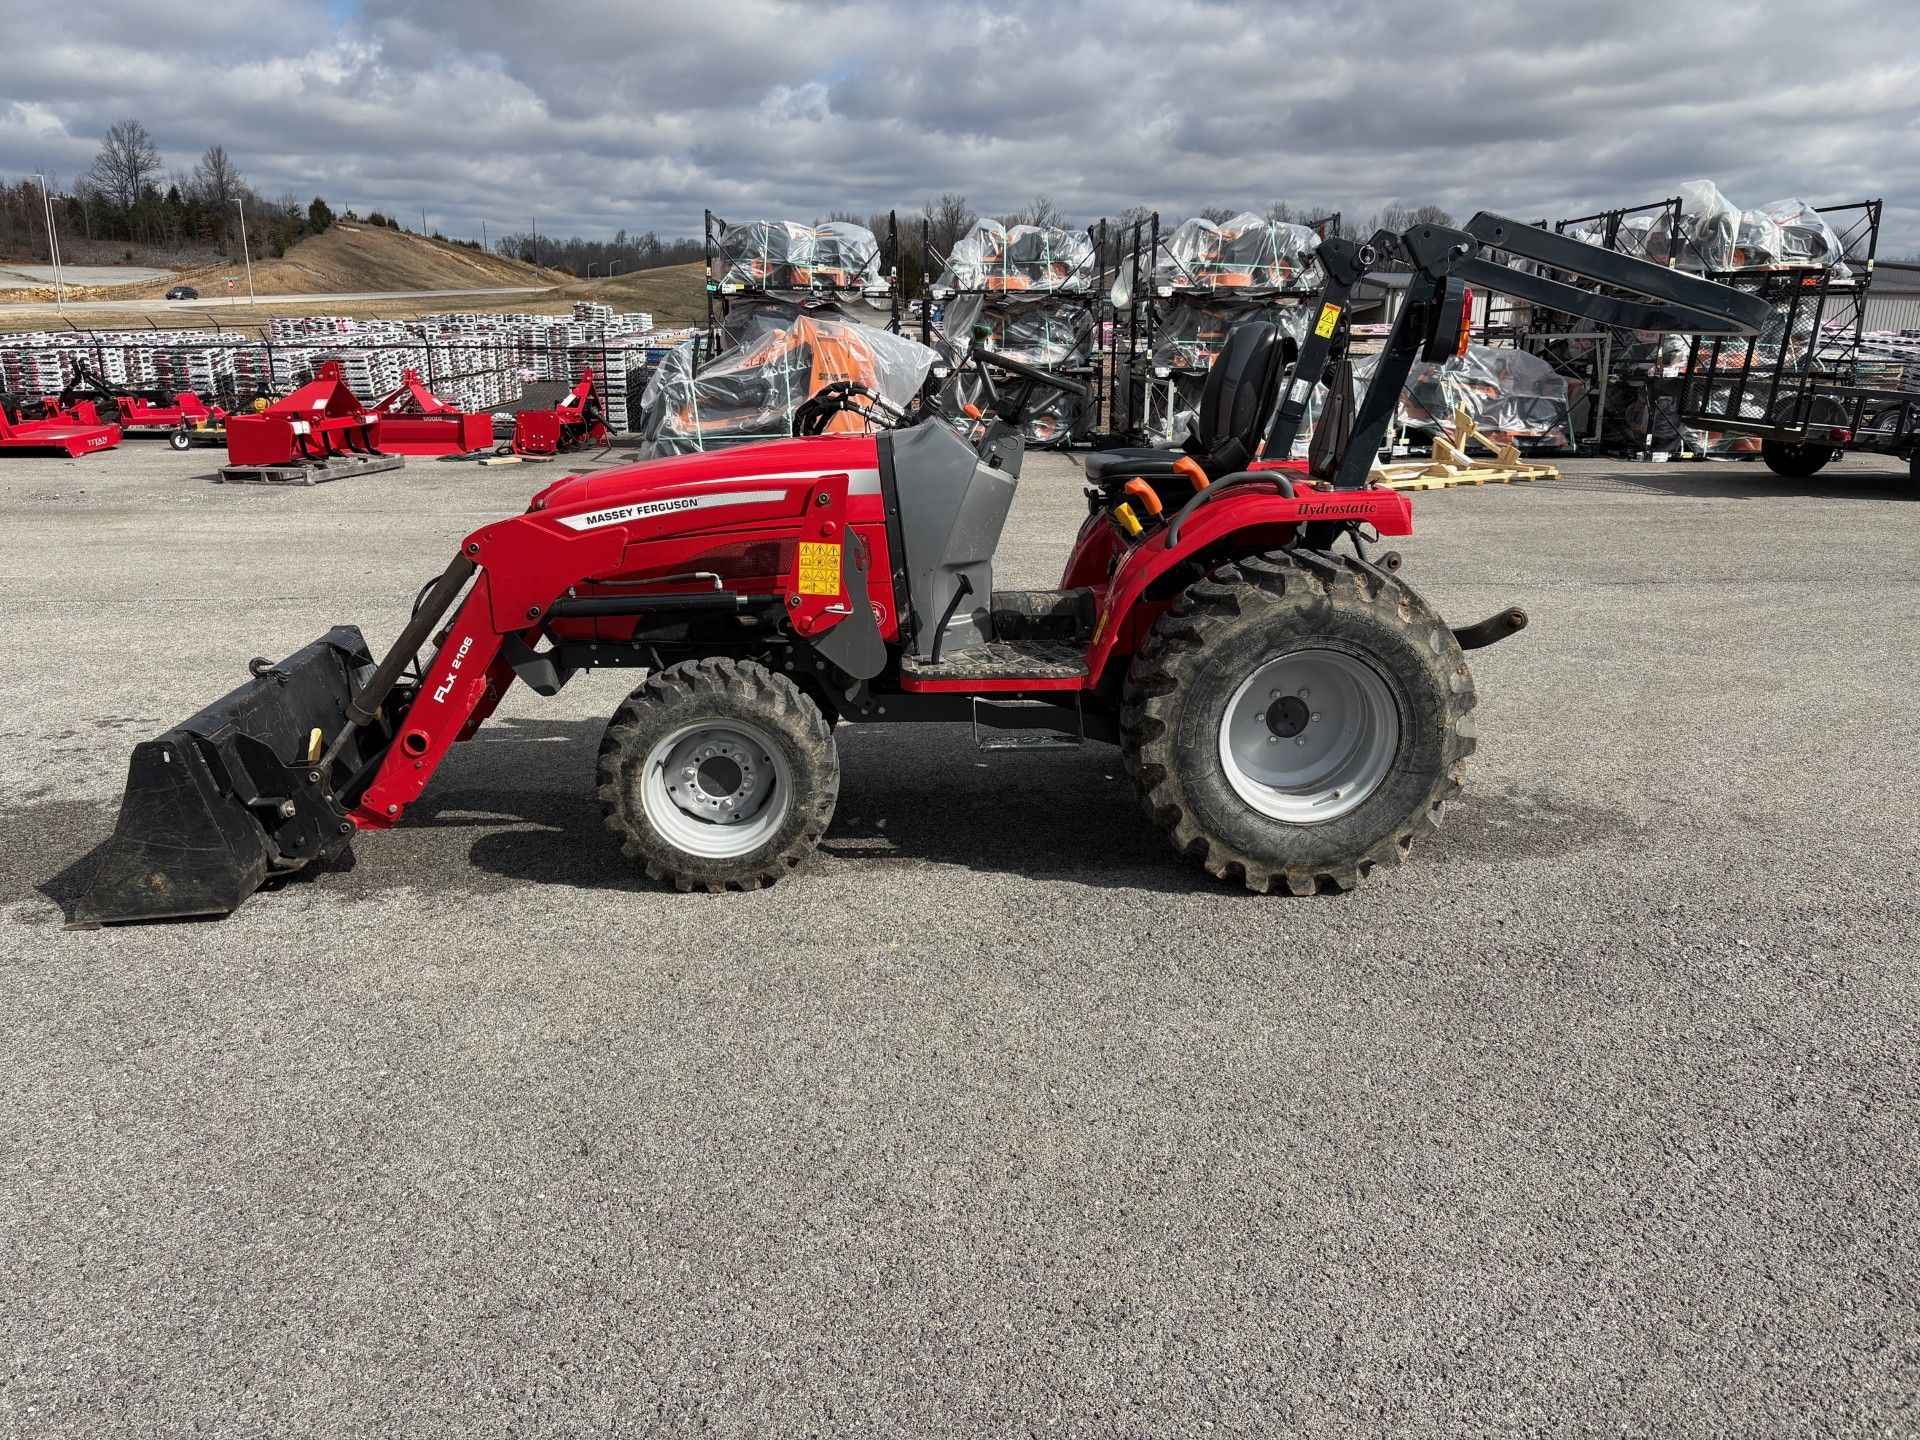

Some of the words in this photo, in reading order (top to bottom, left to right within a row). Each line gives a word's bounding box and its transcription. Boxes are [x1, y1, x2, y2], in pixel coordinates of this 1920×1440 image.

[87, 436, 108, 446] TITAN
[586, 508, 633, 525] MASSEY
[637, 499, 698, 514] FERGUSON
[1297, 502, 1377, 517] Hydrostatic
[452, 636, 473, 670] 2106
